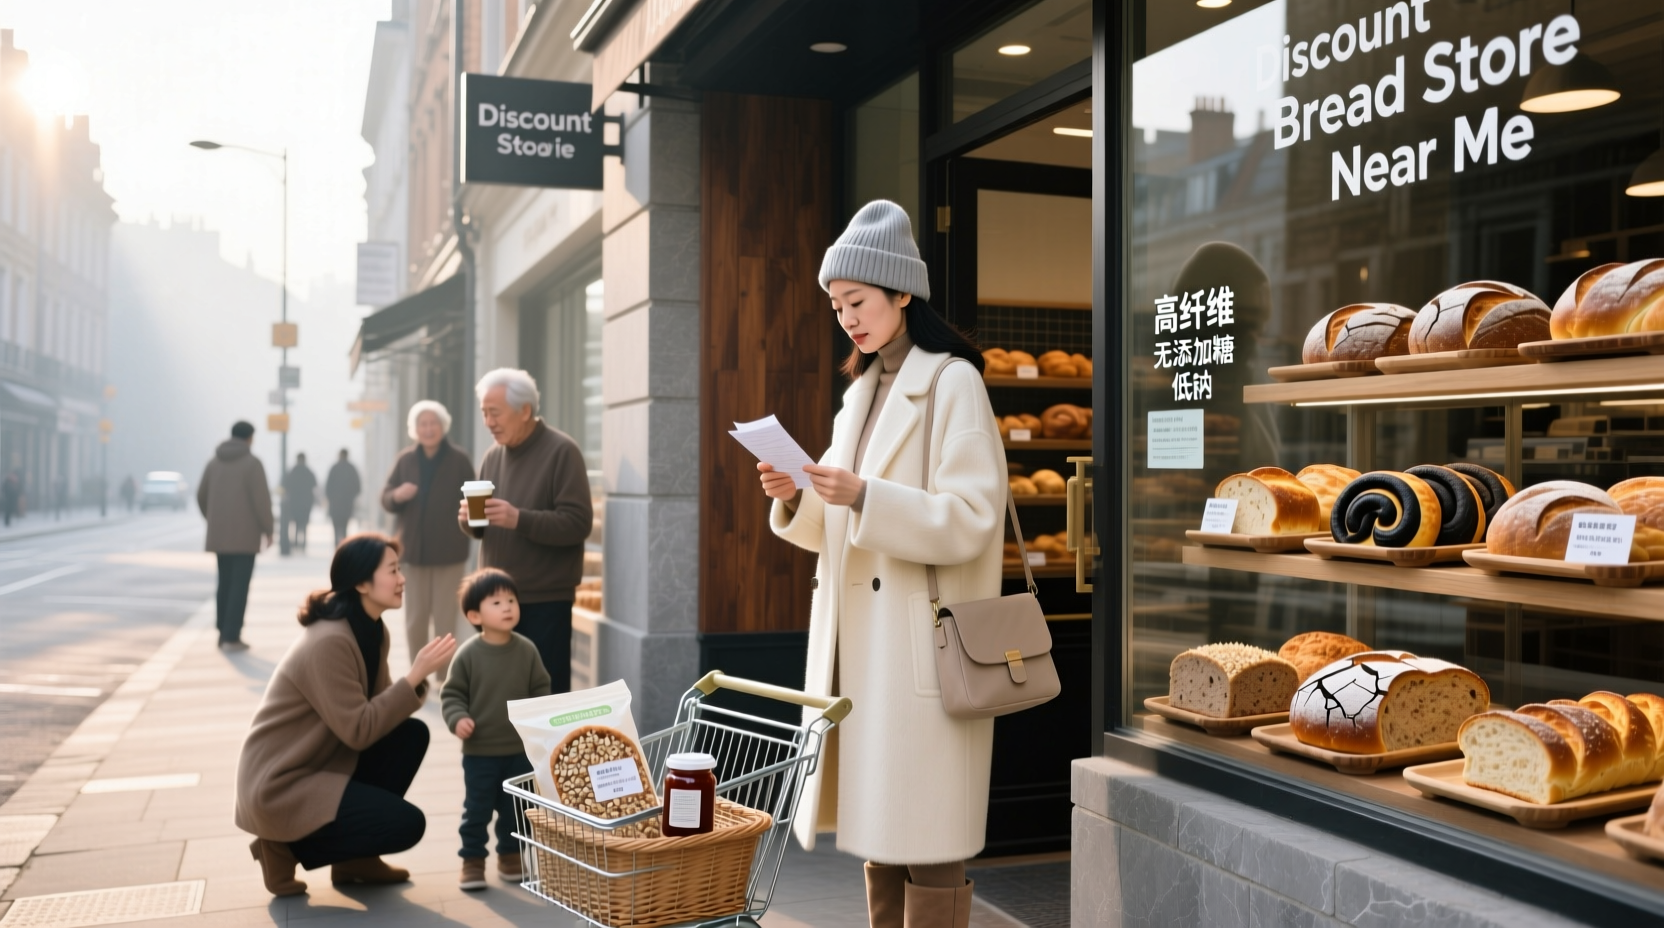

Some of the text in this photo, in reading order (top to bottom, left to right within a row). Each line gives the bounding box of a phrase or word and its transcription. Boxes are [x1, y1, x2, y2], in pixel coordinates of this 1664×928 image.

[1256, 0, 1431, 92] Discount
[1273, 13, 1580, 150] Bread Store
[478, 102, 592, 134] Discount
[1331, 106, 1535, 202] Near Me
[1154, 285, 1235, 335] 高纤维
[1153, 334, 1235, 370] 无添加糖
